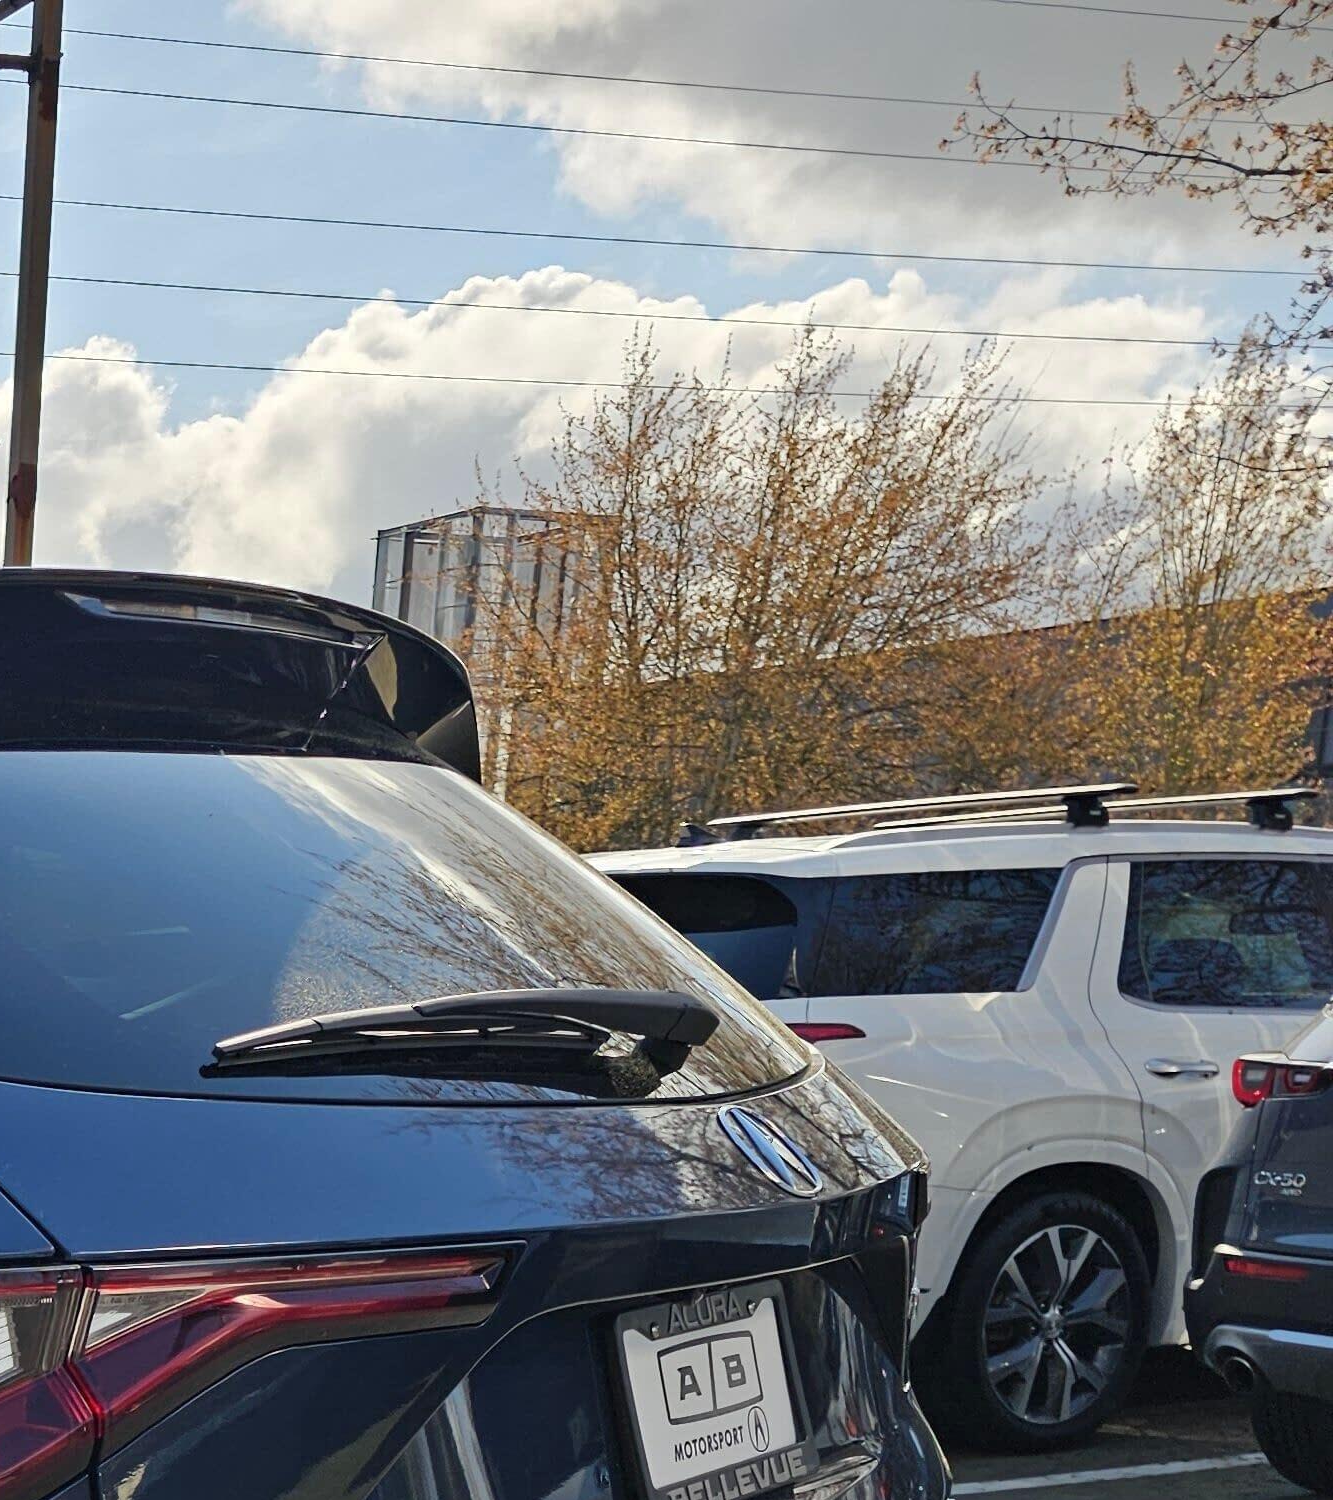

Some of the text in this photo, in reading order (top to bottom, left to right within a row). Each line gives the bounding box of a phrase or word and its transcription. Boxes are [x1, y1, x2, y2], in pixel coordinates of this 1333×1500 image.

[1253, 1170, 1307, 1188] CX-50
[667, 1291, 743, 1335] ACURA
[677, 1353, 747, 1401] A B
[674, 1425, 745, 1463] MOTORSPORT
